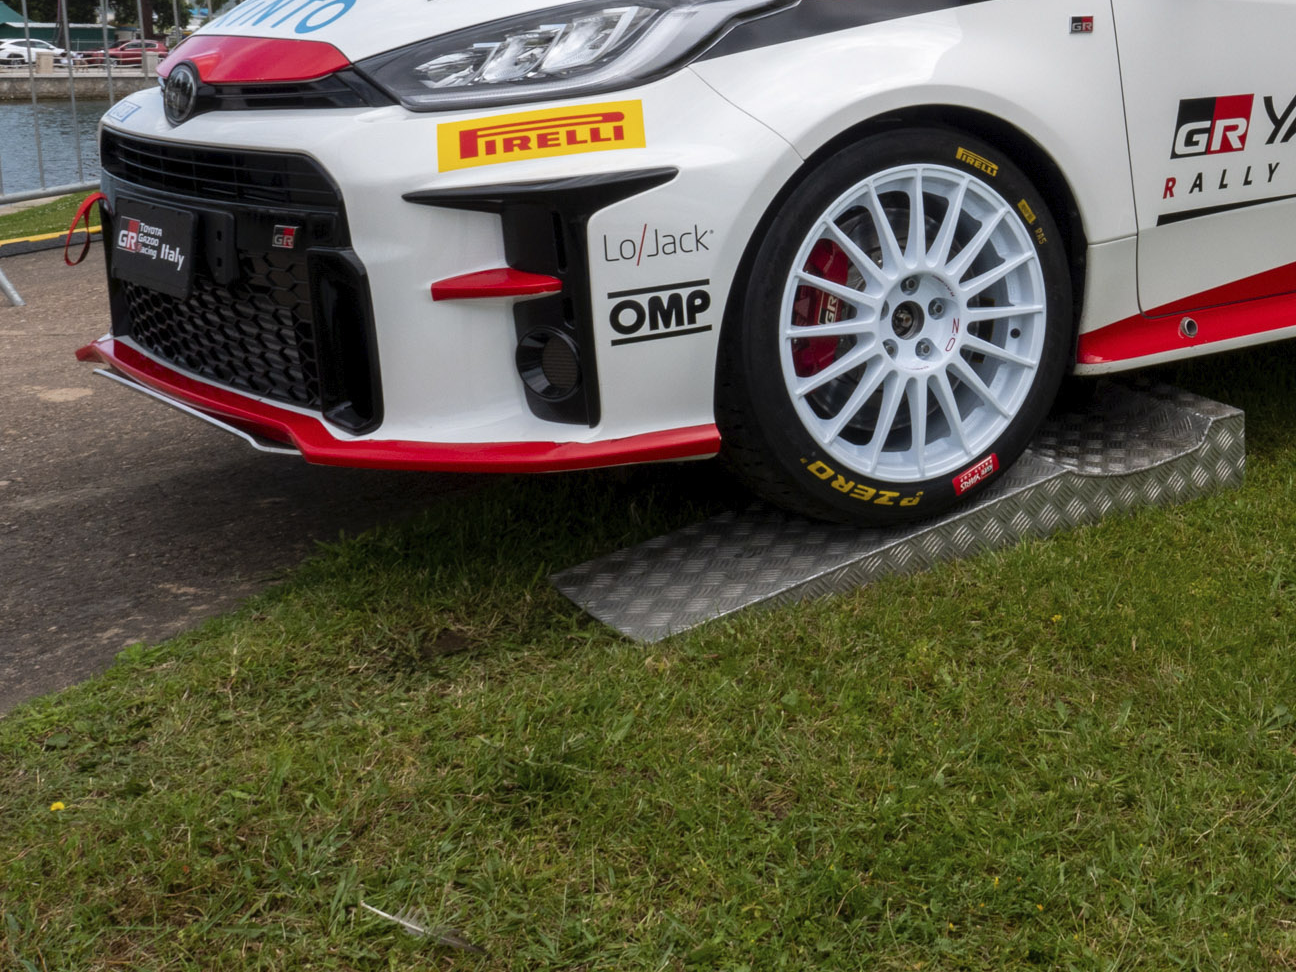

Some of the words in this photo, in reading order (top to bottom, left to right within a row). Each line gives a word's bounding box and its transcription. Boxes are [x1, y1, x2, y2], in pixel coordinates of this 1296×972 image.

[459, 111, 625, 160] PIRELLI
[1173, 117, 1248, 155] GR
[955, 146, 999, 178] PIRELLI
[1162, 162, 1280, 200] RALLY
[118, 229, 138, 250] GR
[139, 222, 163, 237] TOYOTA
[274, 234, 294, 247] GR
[161, 243, 185, 271] Italy
[609, 289, 711, 335] OMP
